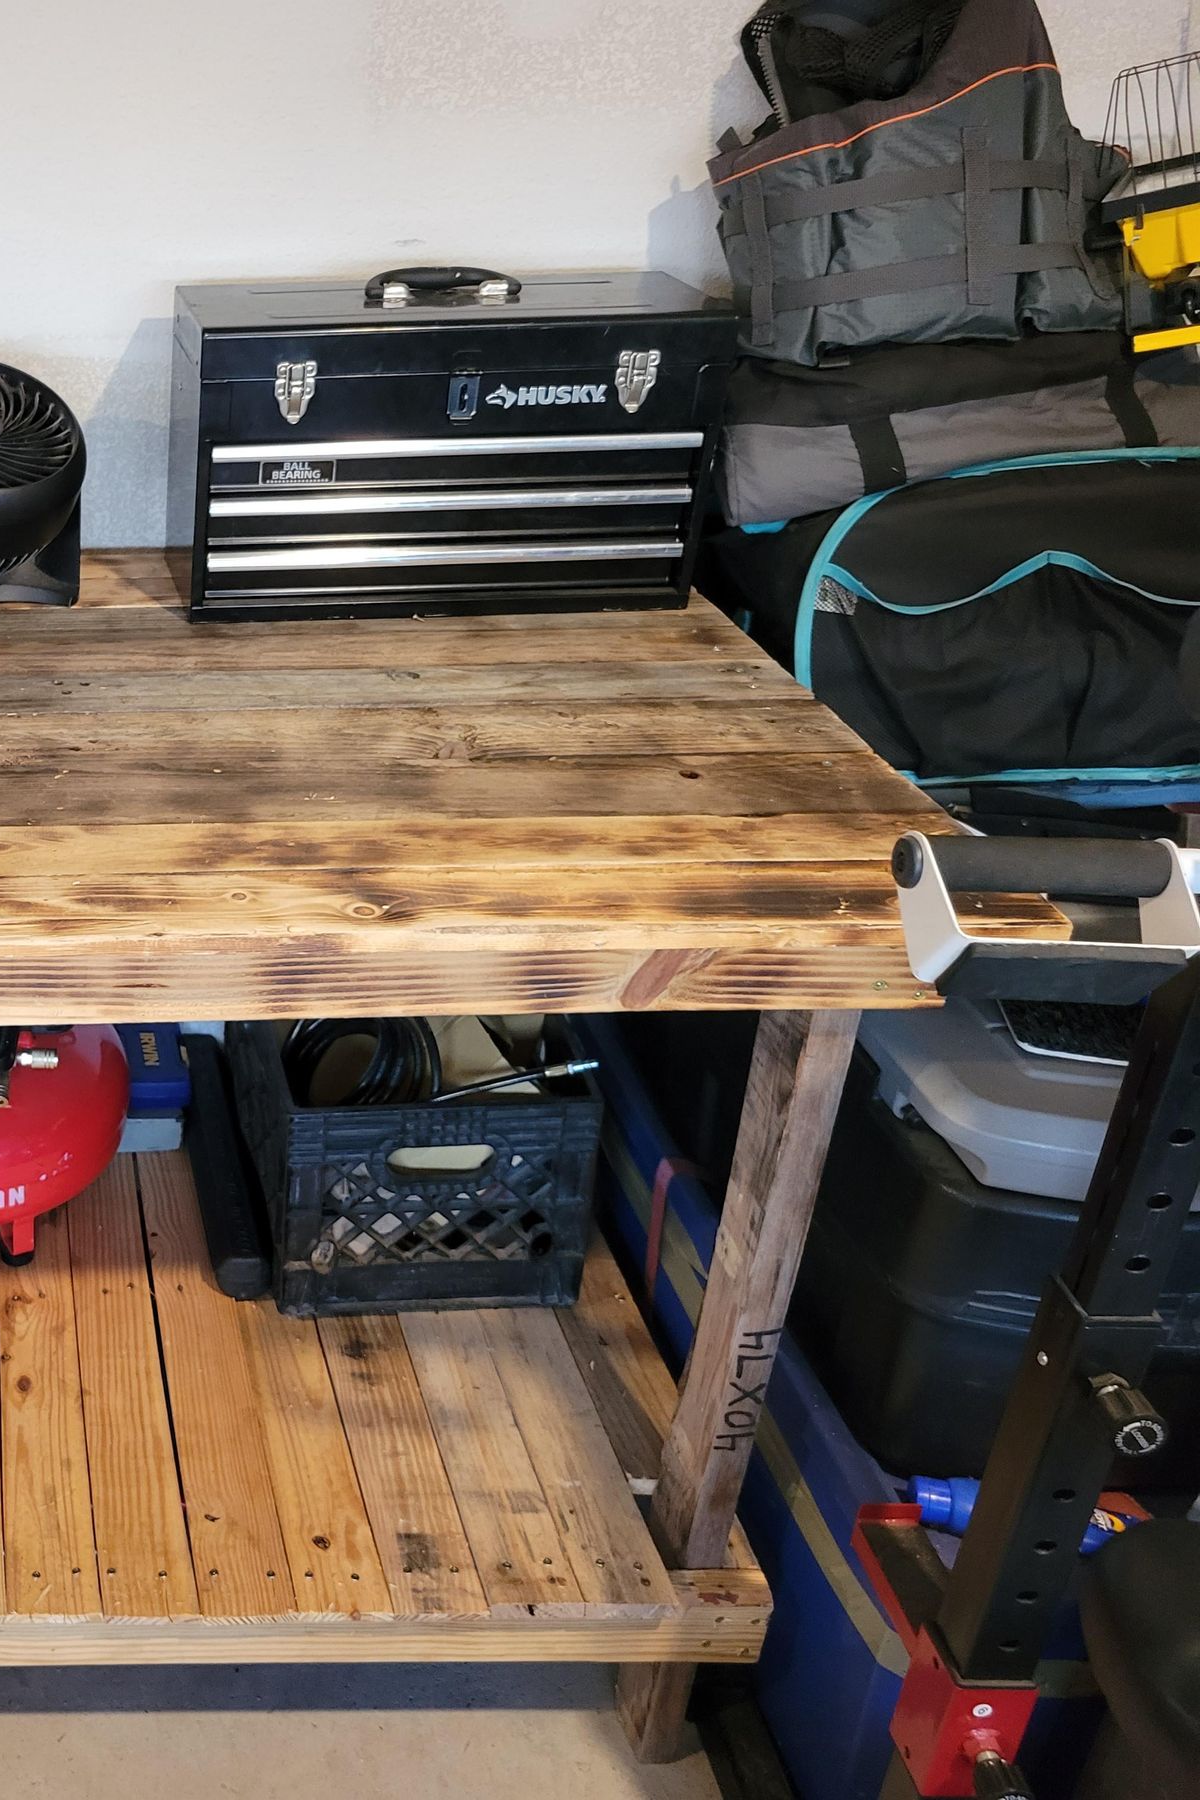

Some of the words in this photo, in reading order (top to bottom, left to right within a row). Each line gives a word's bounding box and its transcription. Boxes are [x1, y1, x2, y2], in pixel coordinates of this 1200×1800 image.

[517, 384, 608, 406] HUSKY
[283, 462, 311, 471] BALL
[272, 470, 322, 480] BEARING
[140, 1032, 160, 1066] IRWIN
